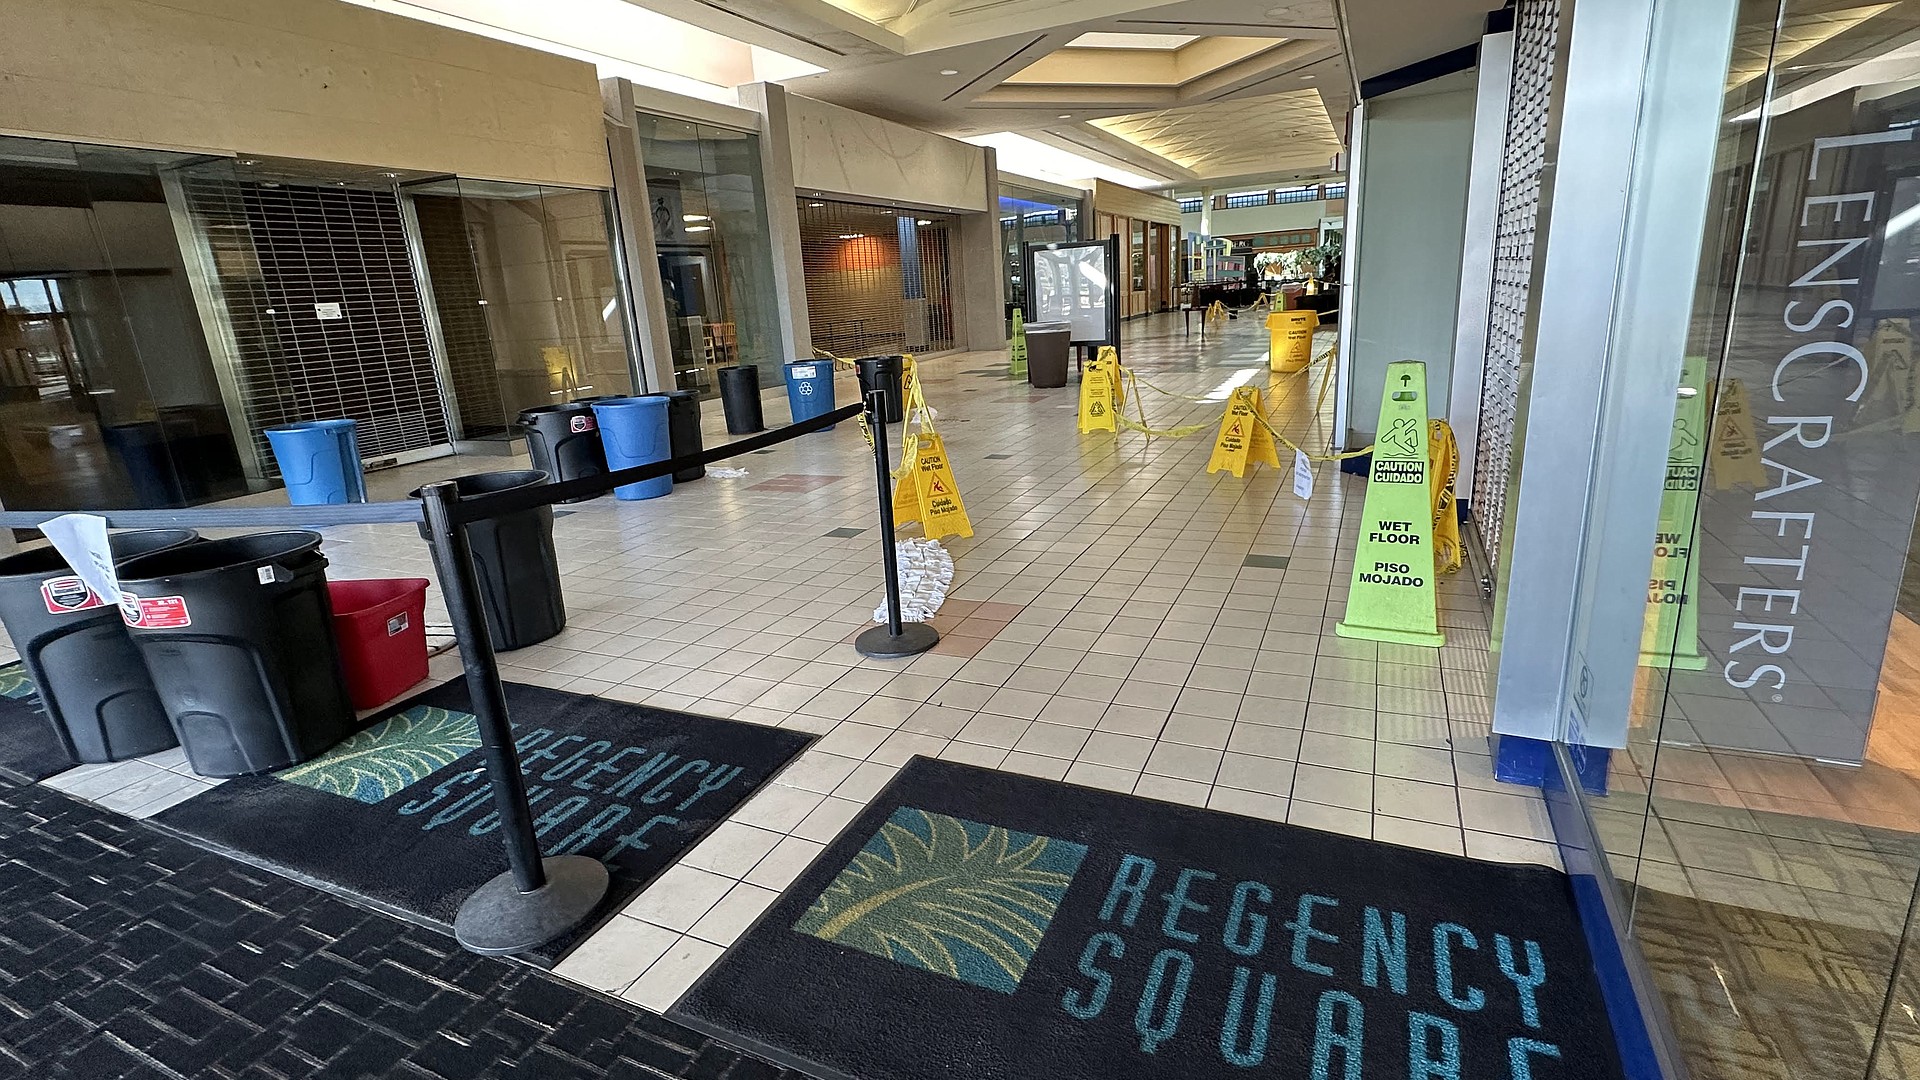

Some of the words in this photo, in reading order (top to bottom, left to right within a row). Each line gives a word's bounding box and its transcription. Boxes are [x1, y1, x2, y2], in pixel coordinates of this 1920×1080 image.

[921, 455, 941, 465] CAUTION
[921, 464, 931, 472] Wet
[931, 463, 943, 471] Floor
[1375, 461, 1422, 472] CAUTION
[1374, 472, 1422, 483] CUIDADO
[932, 497, 952, 508] Cuidado
[930, 508, 940, 516] Piso
[941, 505, 958, 515] Mojado
[1379, 520, 1412, 531] WET
[1369, 532, 1420, 545] FLOOR
[1374, 562, 1410, 574] PISO
[1359, 573, 1424, 587] MOJADO
[1098, 854, 1547, 1029] REGENCY
